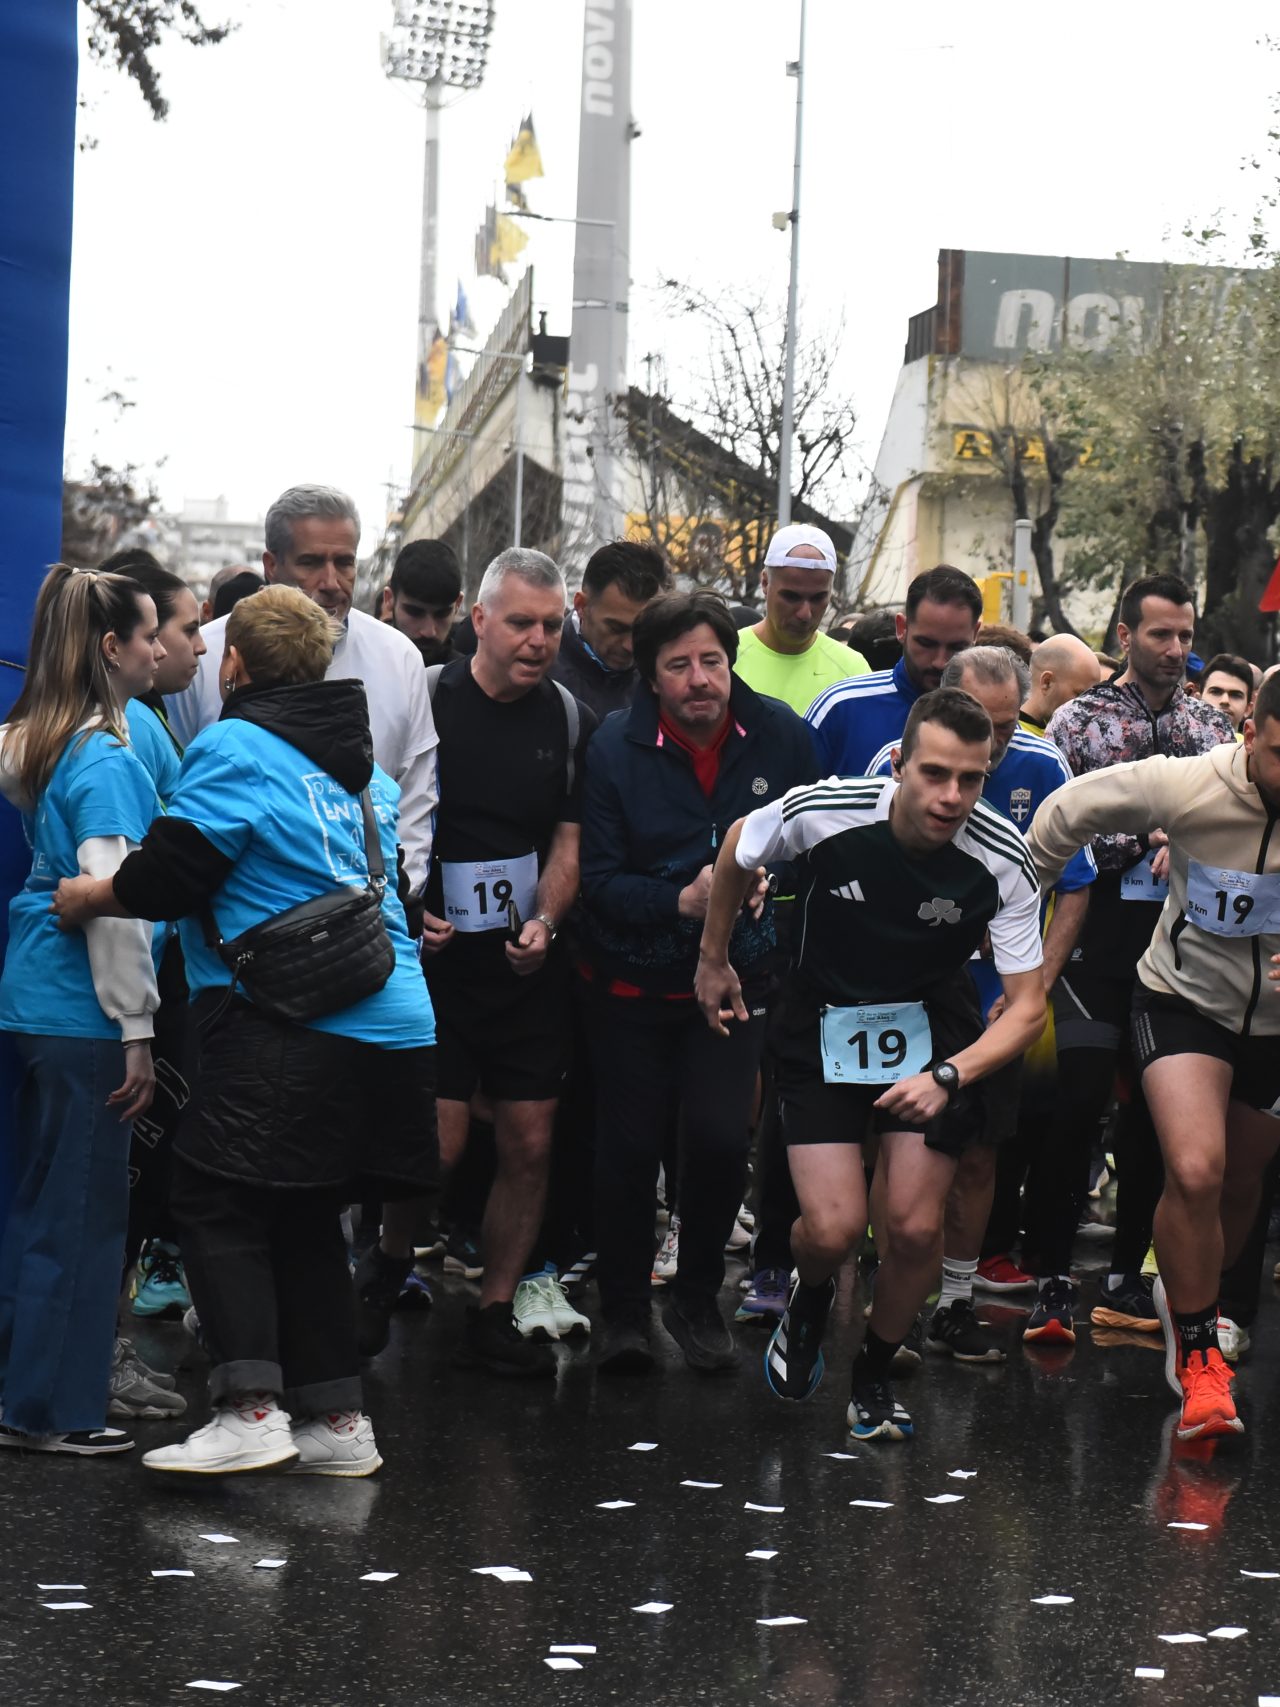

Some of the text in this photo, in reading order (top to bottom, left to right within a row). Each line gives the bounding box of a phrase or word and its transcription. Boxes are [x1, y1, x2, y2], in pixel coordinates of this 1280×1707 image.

[1131, 878, 1144, 886] km
[473, 879, 513, 915] 19
[455, 907, 469, 916] km
[1195, 903, 1208, 917] km
[1215, 889, 1255, 925] 19
[847, 1029, 908, 1070] 19
[834, 1061, 841, 1070] 5
